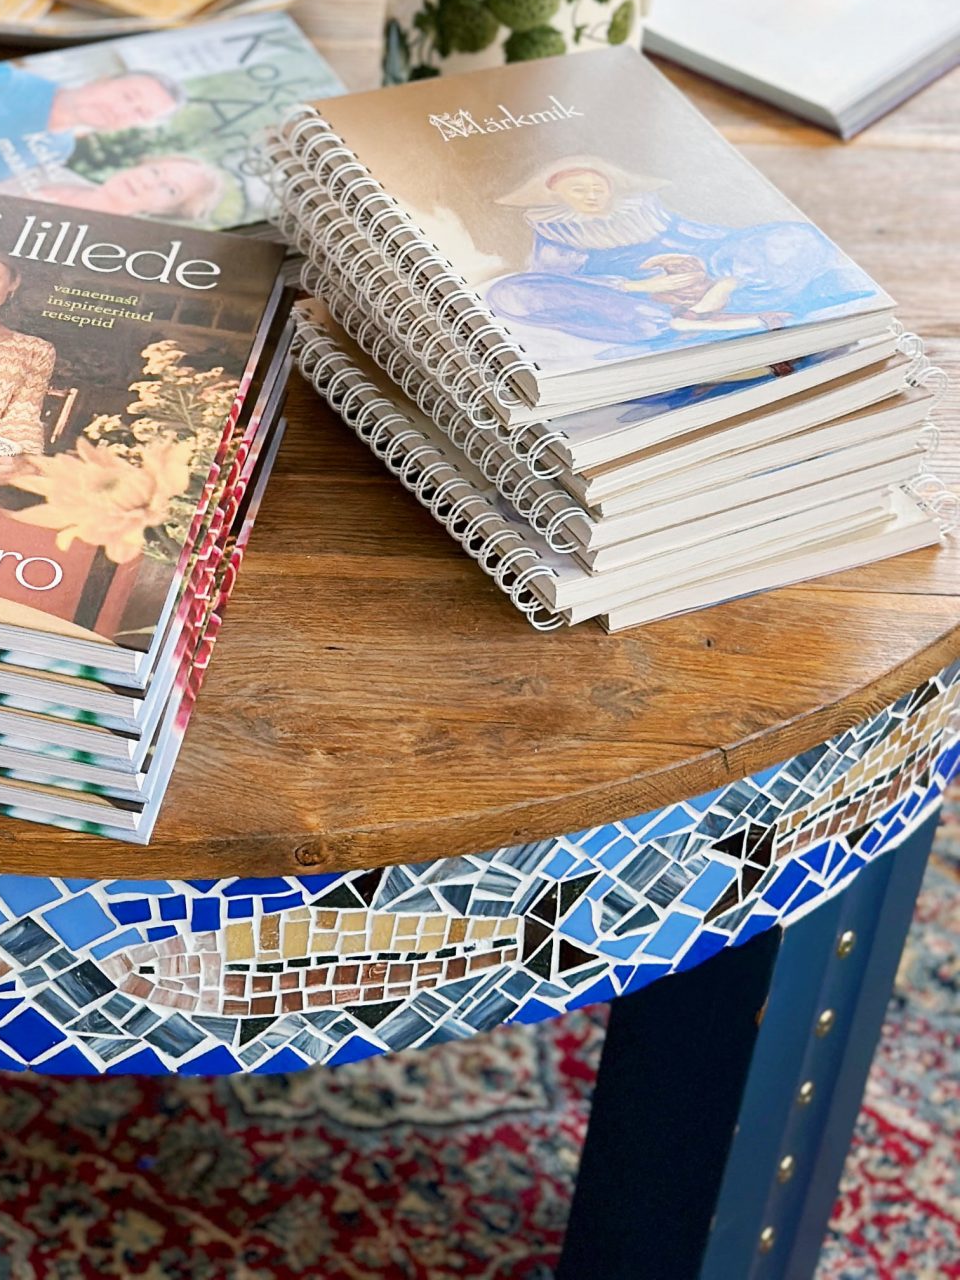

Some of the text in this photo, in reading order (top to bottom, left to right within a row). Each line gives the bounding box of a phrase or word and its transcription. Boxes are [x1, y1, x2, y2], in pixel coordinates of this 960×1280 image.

[427, 95, 585, 142] Märkmik
[8, 214, 222, 291] lillede
[46, 295, 154, 324] inspireeritud
[53, 284, 140, 307] vanaemast
[40, 308, 116, 330] retseptid
